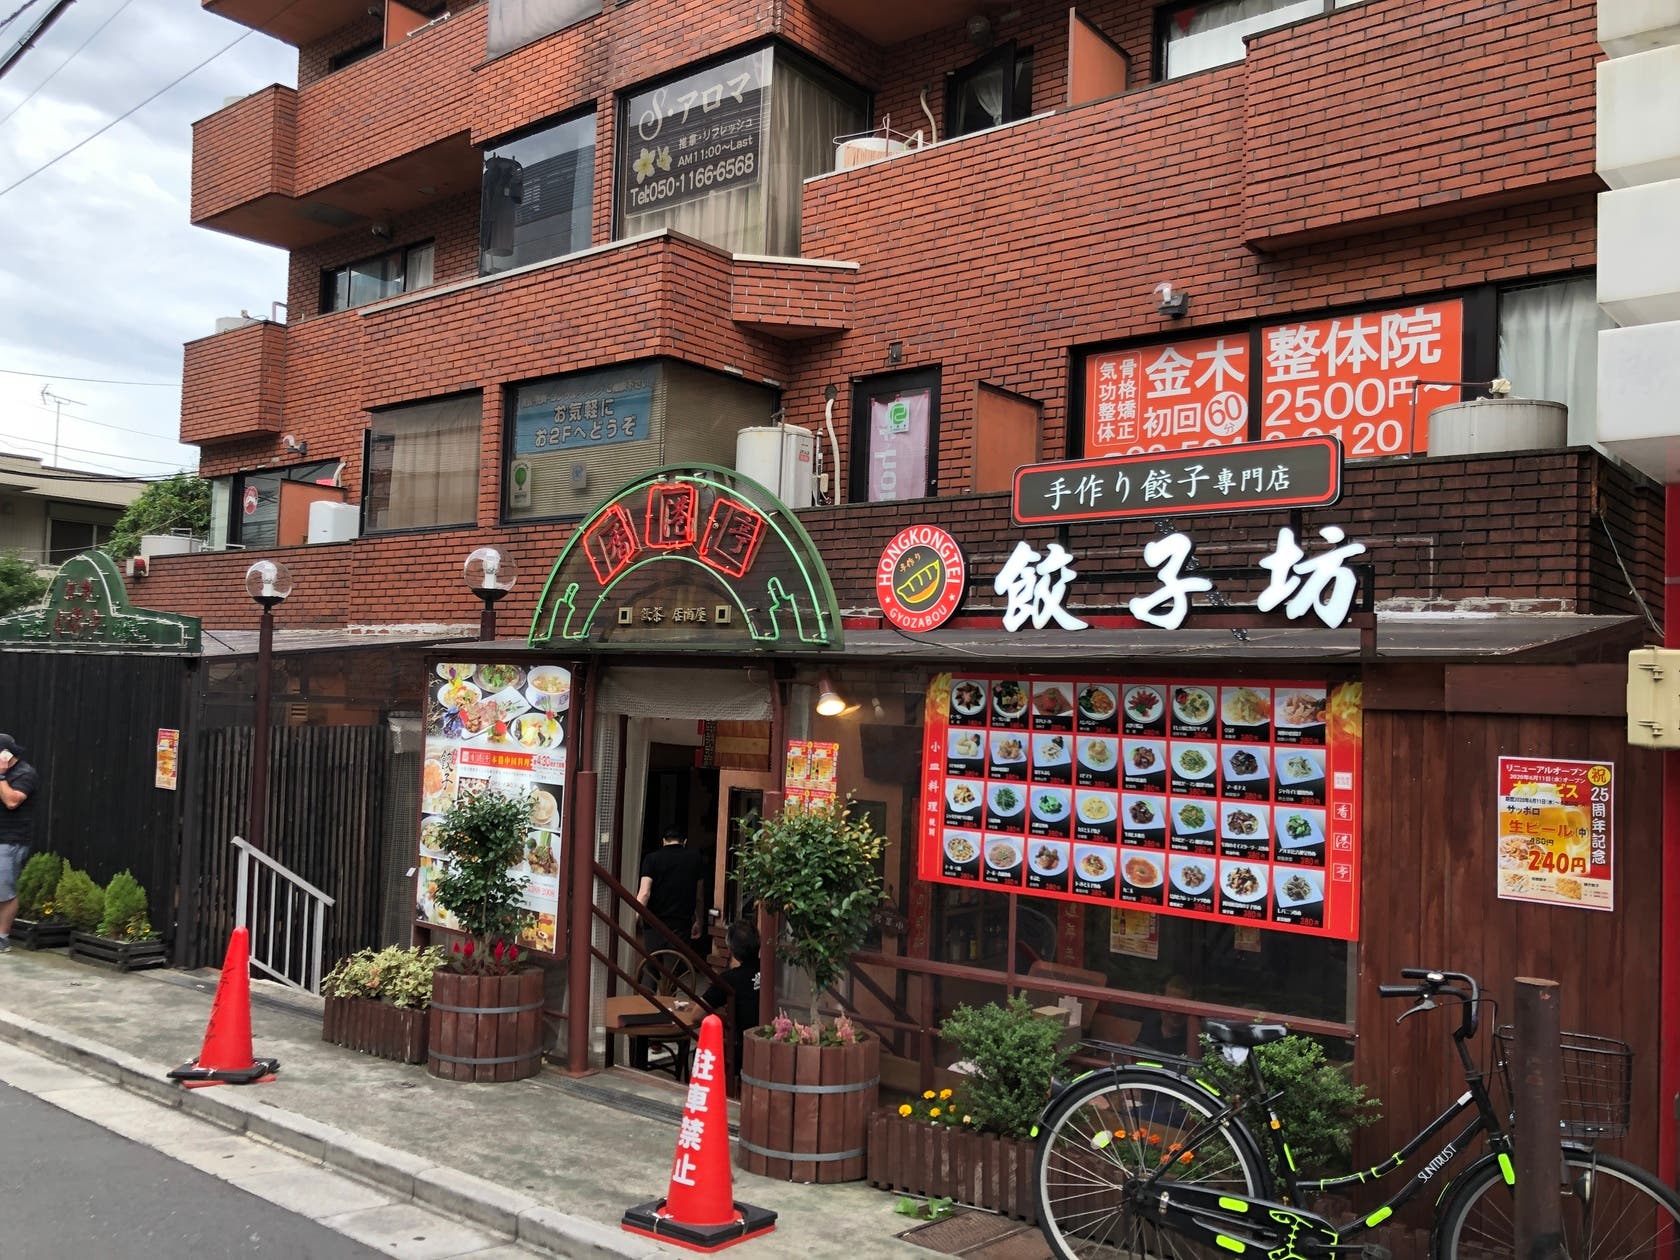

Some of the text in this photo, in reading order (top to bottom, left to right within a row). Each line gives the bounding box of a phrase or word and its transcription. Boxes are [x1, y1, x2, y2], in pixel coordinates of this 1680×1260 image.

[1145, 307, 1442, 399] 金木 整体院
[553, 397, 616, 425] お気軽に
[1096, 361, 1118, 443] 気功整体
[1117, 358, 1137, 440] 骨格矯正
[534, 415, 638, 448] お2Fへどうぞ
[1143, 402, 1201, 439] 初回
[878, 527, 961, 586] HONGKONGTEI
[993, 526, 1368, 632] 餃子坊
[889, 604, 947, 629] GYOZABOU
[1505, 763, 1588, 777] リニューアルオープン
[1591, 767, 1607, 783] 祝
[1507, 804, 1541, 816] サッポロ
[1590, 786, 1609, 865] 25周年記念
[1528, 850, 1587, 875] 240円
[672, 1048, 717, 1187] 駐車禁止
[1417, 1142, 1457, 1184] SUNTRUST
